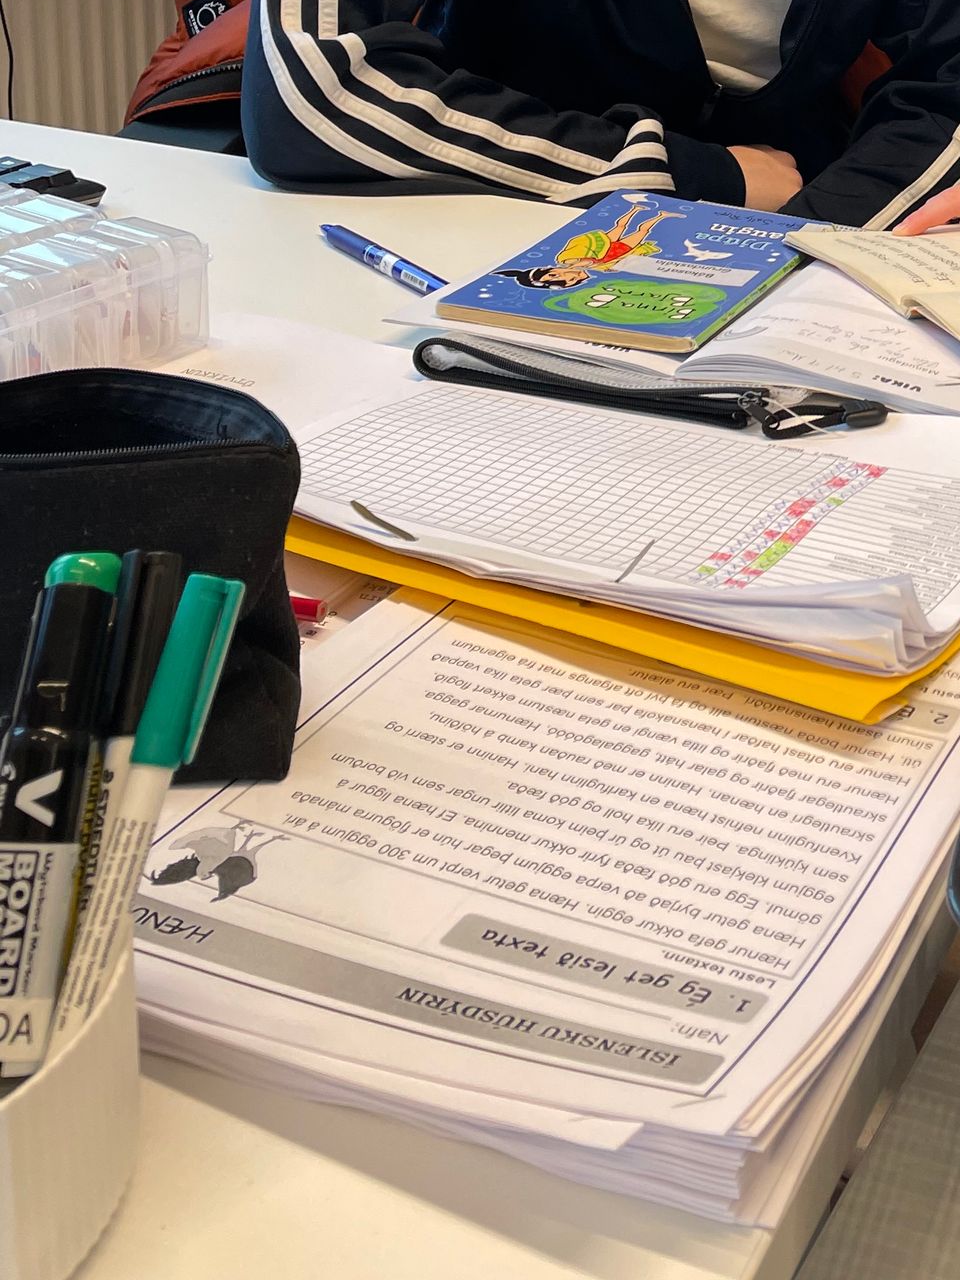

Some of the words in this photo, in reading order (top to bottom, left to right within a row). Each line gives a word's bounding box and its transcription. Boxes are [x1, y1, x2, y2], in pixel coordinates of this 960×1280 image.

[710, 223, 785, 239] augin
[655, 259, 732, 272] Grundaskóla
[657, 266, 715, 278] Bókasafn
[584, 293, 621, 309] B
[602, 285, 695, 307] Bjarna
[621, 300, 697, 320] Binna
[872, 374, 922, 392] VIKA:
[472, 684, 516, 702] ekkert
[518, 698, 576, 719] næstum
[384, 721, 404, 732] og
[468, 705, 542, 732] Hænurnar
[577, 714, 612, 728] geta
[928, 710, 949, 726] 2.
[402, 728, 447, 745] stærri
[482, 730, 496, 738] á
[612, 723, 632, 732] en
[632, 727, 678, 744] vængi
[446, 742, 465, 750] er
[497, 734, 538, 752] kamb
[682, 740, 708, 754] litla
[709, 746, 730, 758] og
[330, 753, 387, 776] borðum
[466, 746, 519, 769] Haninn
[539, 746, 592, 765] rauðan
[731, 754, 776, 773] fjaðrir
[386, 769, 409, 781] við
[593, 760, 628, 774] með
[628, 769, 646, 778] er
[687, 763, 728, 778] galar
[778, 767, 813, 782] með
[336, 778, 350, 788] á
[412, 776, 446, 791] sem
[560, 774, 638, 801] karlfuglinn
[648, 773, 703, 796] Haninn
[729, 773, 750, 785] og
[815, 777, 842, 789] eru
[348, 783, 392, 802] liggur
[445, 787, 491, 806] ungar
[548, 794, 582, 807] góð
[640, 794, 660, 805] en
[751, 782, 797, 801] fjaðrir
[844, 785, 899, 806] Hænur
[291, 791, 352, 814] mánaða
[392, 795, 439, 816] hæna
[491, 802, 521, 817] litlir
[581, 800, 602, 813] og
[663, 800, 709, 821] hæna
[798, 795, 888, 823] skrautlegar
[352, 808, 412, 834] fjögurra
[435, 809, 458, 822] Ef
[522, 810, 567, 830] koma
[602, 808, 634, 824] holl
[768, 808, 789, 819] en
[306, 821, 320, 832] á
[410, 827, 430, 838] er
[568, 822, 610, 842] þeim
[636, 816, 665, 832] líka
[666, 825, 694, 838] eru
[710, 814, 764, 835] nefnist
[790, 814, 875, 842] skrautlegri
[321, 825, 378, 848] eggjum
[432, 833, 463, 850] hún
[608, 834, 627, 846] úr
[629, 837, 651, 850] og
[695, 835, 730, 852] Þeir
[378, 844, 411, 860] 300
[463, 843, 514, 865] þegar
[531, 837, 577, 856] okkur
[652, 845, 670, 858] út
[767, 830, 862, 865] Kvenfuglinn
[412, 853, 439, 867] um
[513, 857, 572, 880] eggjum
[578, 851, 612, 868] fyrir
[673, 851, 707, 870] þau
[438, 861, 480, 880] verpt
[614, 860, 656, 880] fæða
[706, 861, 770, 888] klekjast
[812, 867, 849, 883] sem
[482, 875, 529, 893] getur
[575, 875, 620, 895] verpa
[658, 873, 692, 888] góð
[693, 883, 721, 896] eru
[528, 888, 580, 912] Hæna
[624, 890, 647, 902] að
[724, 890, 760, 910] Egg
[773, 880, 835, 904] eggjum
[649, 897, 702, 920] byrjað
[0, 852, 33, 995] BOARD
[635, 920, 684, 938] okkur
[702, 912, 751, 930] getur
[481, 929, 549, 959] texta
[688, 933, 728, 950] gefa
[752, 925, 806, 949] Hæna
[555, 952, 617, 980] lesið
[662, 950, 725, 975] textann.
[727, 946, 791, 970] Hænur
[623, 970, 675, 988] get
[728, 969, 777, 989] Lestu
[678, 980, 712, 1007] Ég
[395, 985, 537, 1036] HÚSDÝRIN
[730, 995, 752, 1013] 1.
[670, 1020, 729, 1046] Nafn:
[541, 1024, 682, 1068] ÍSLENSKU
